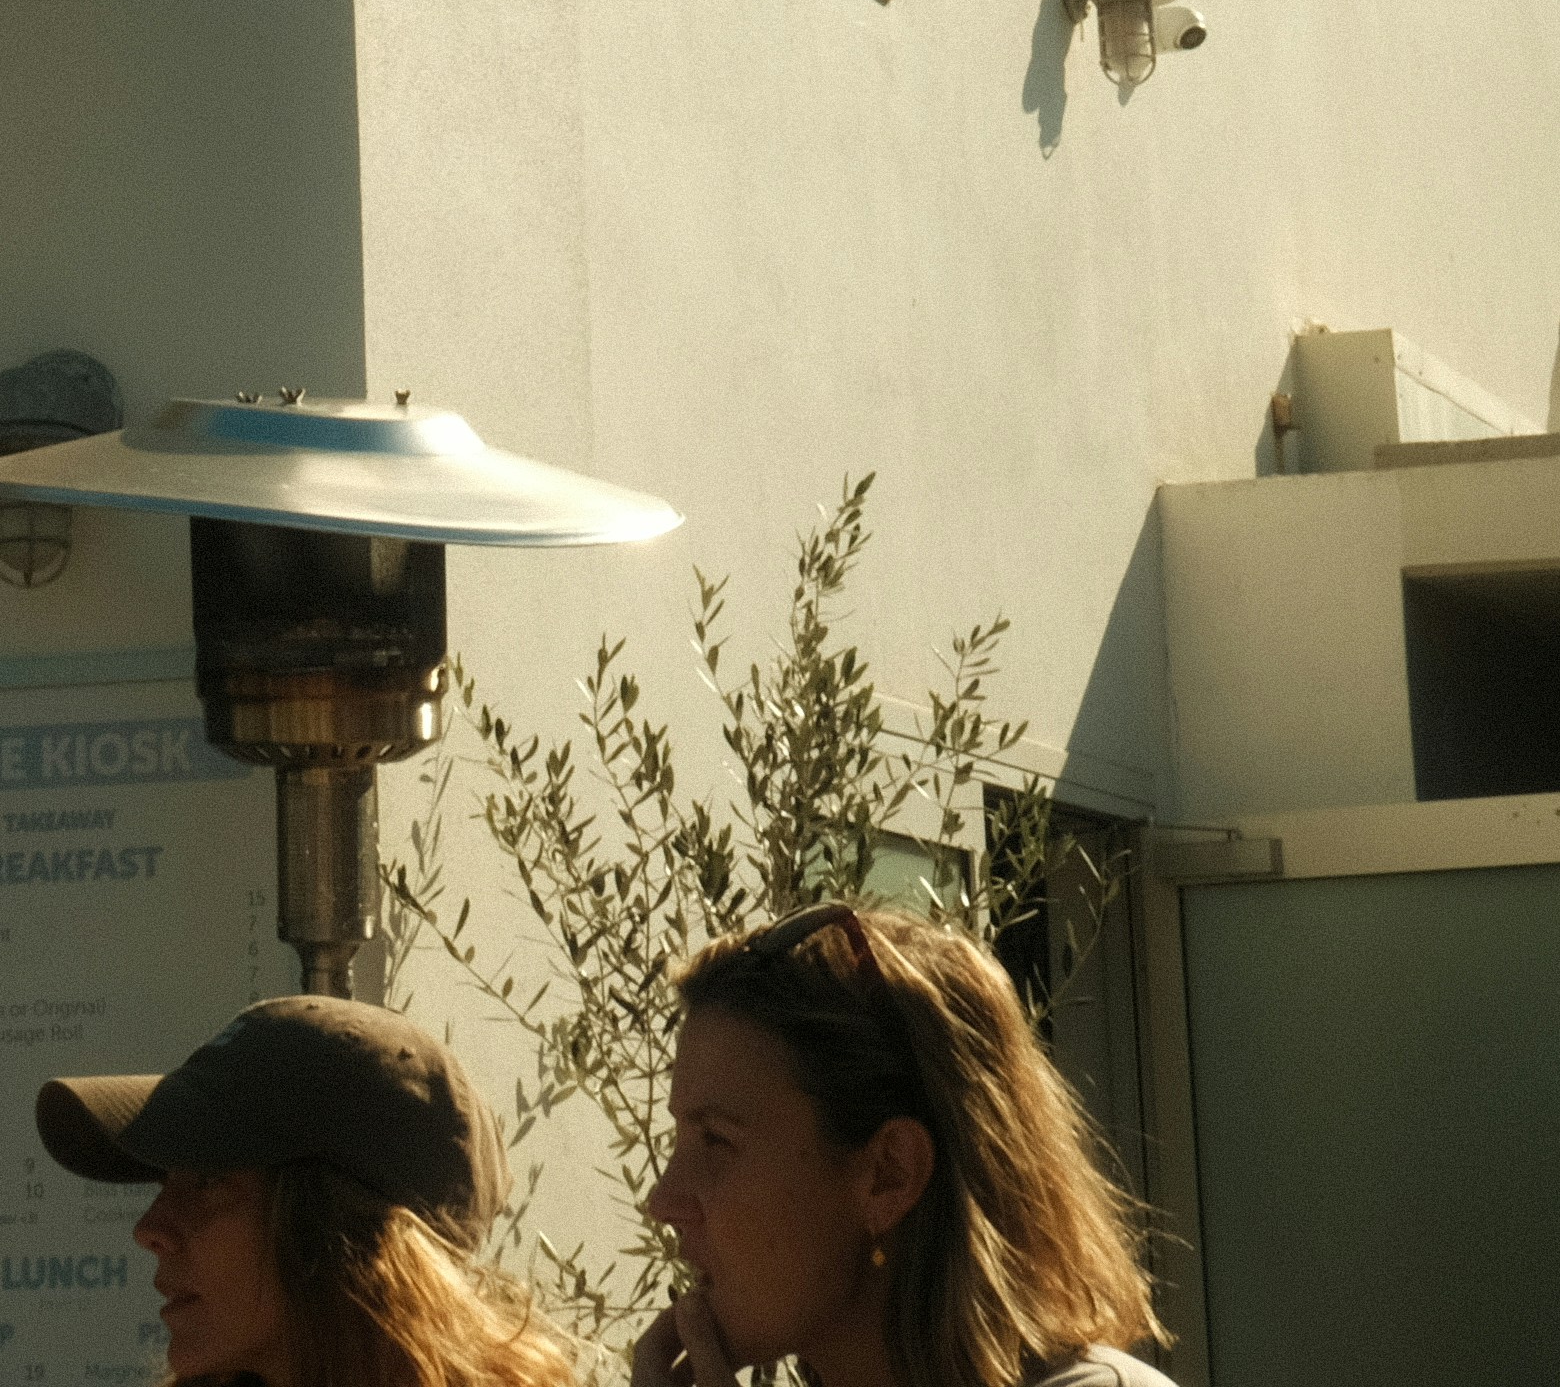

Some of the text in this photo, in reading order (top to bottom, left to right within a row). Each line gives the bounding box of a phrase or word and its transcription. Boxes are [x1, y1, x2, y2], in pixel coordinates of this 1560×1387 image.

[41, 728, 192, 779] KIOSK
[2, 808, 118, 834] TAKEAWAY
[9, 1002, 28, 1017] or
[50, 1023, 84, 1041] Roll
[24, 1181, 45, 1201] 10
[1, 1254, 129, 1291] LUNCH
